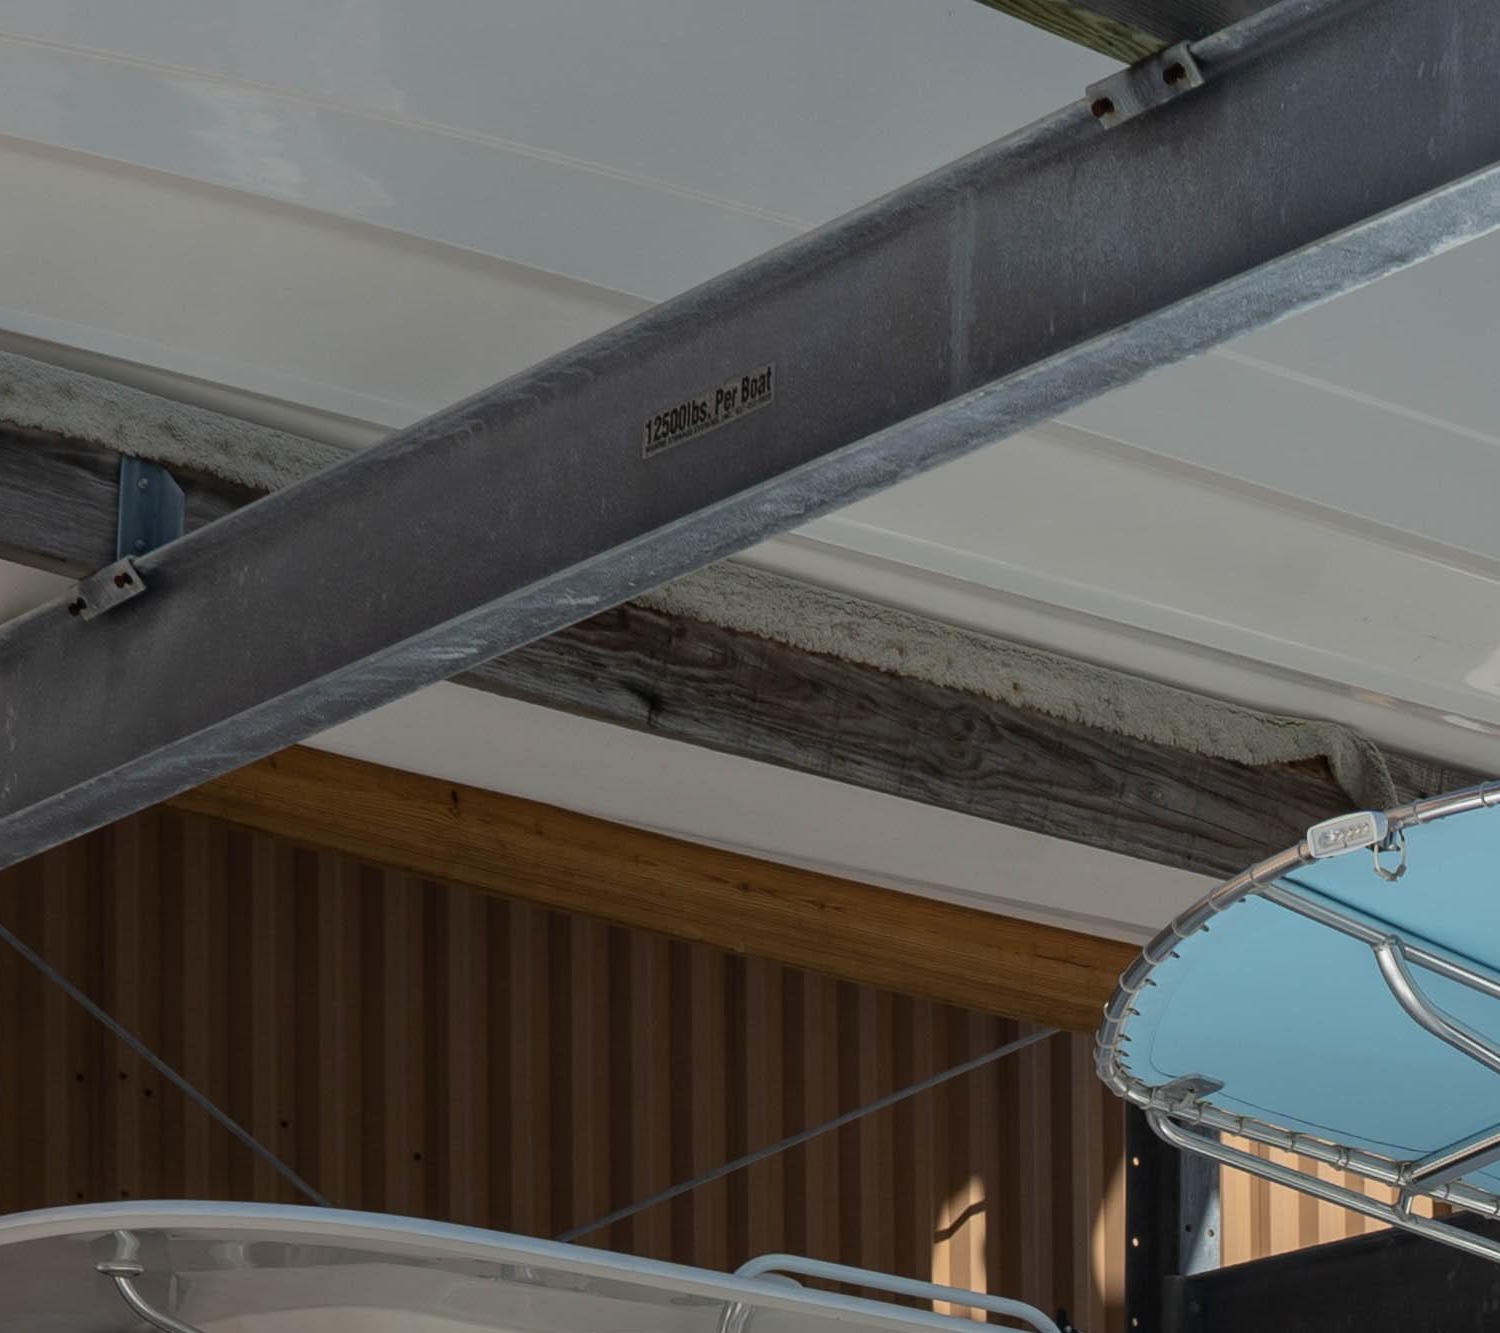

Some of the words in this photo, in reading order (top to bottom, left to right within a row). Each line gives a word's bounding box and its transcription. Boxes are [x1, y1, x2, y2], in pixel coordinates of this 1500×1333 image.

[645, 399, 712, 445] 12500lbs.
[715, 385, 738, 415] Per
[740, 366, 773, 402] Boat
